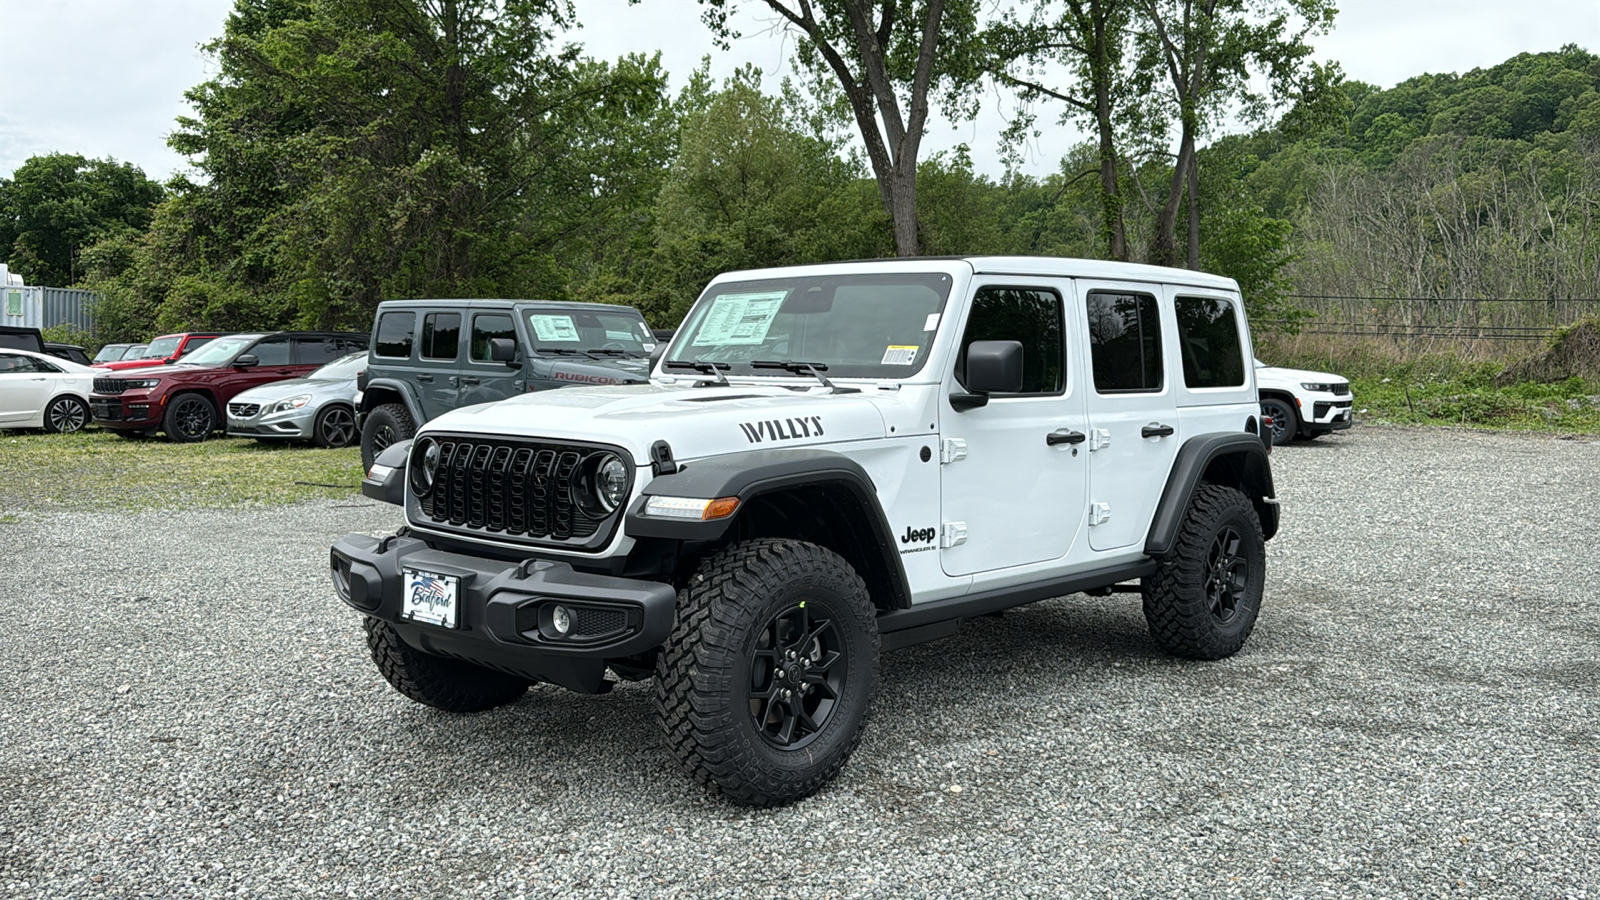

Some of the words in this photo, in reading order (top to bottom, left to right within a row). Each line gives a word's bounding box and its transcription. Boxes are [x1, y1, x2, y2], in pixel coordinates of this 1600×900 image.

[554, 372, 619, 385] RUBICON
[738, 415, 824, 444] WILLYS
[901, 526, 936, 544] Jeep
[410, 581, 452, 612] Bedford
